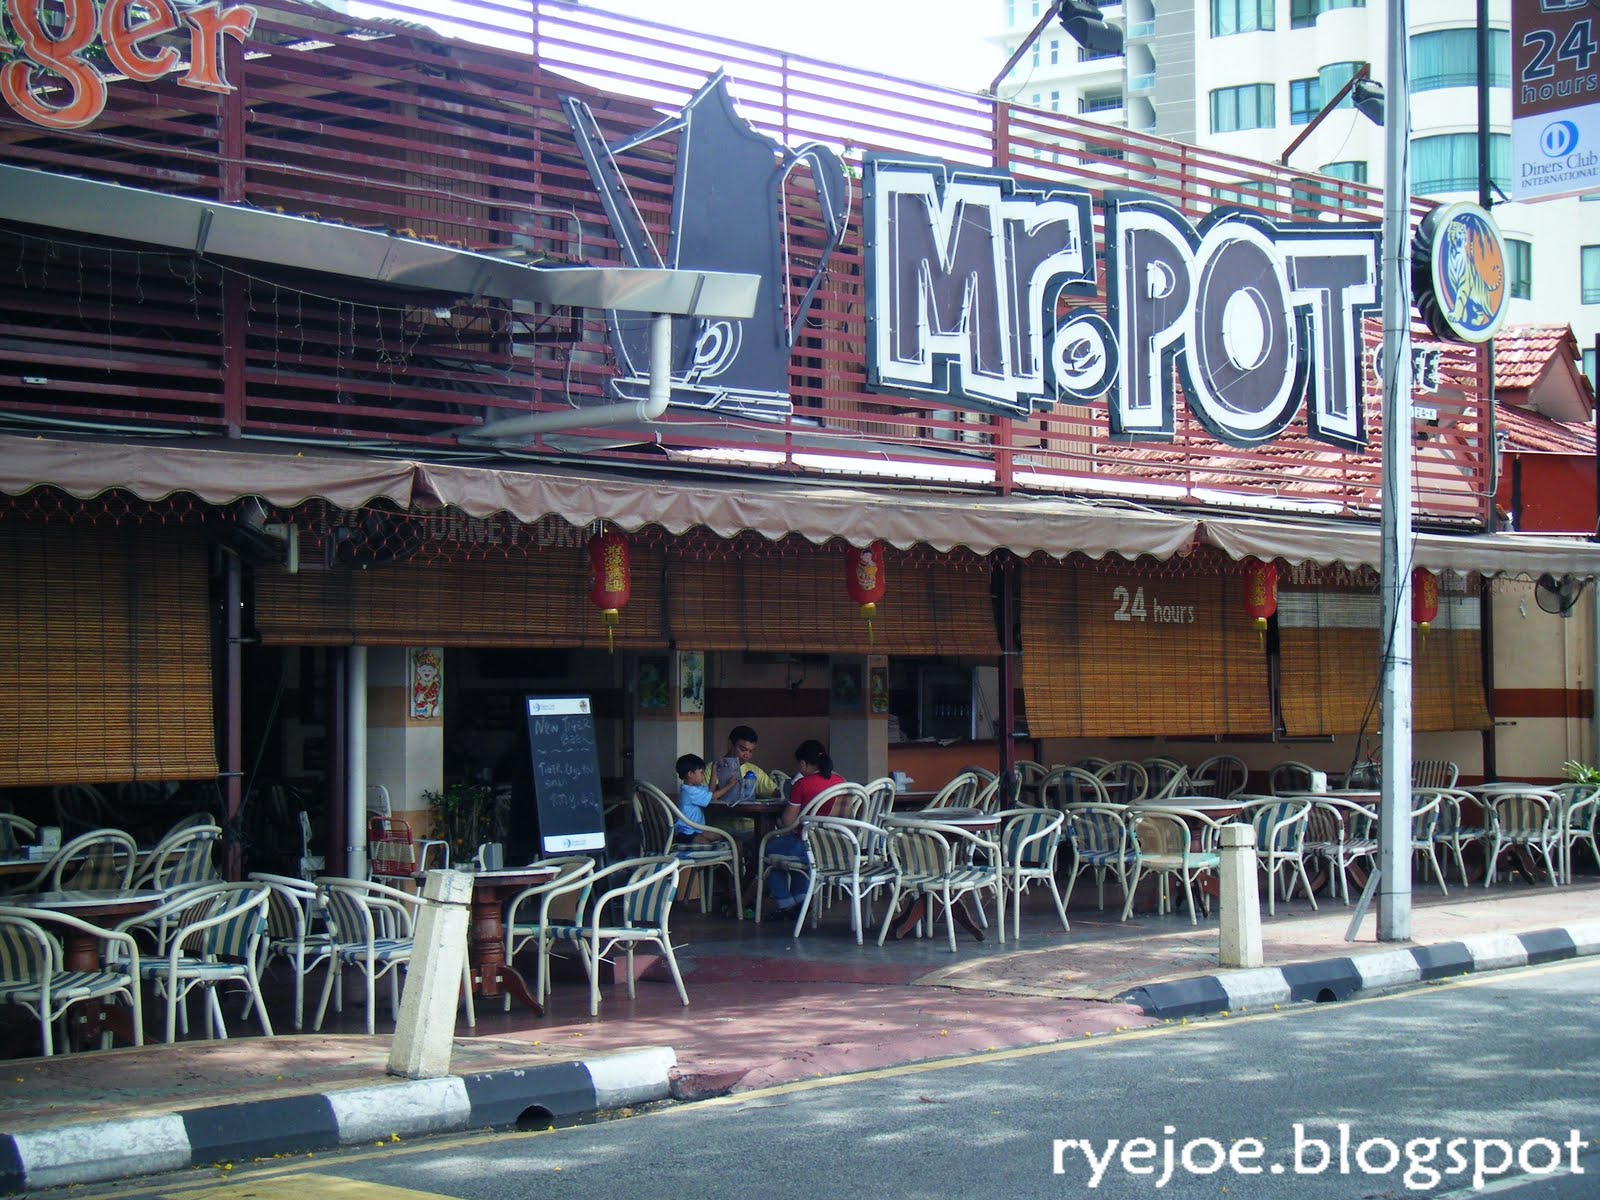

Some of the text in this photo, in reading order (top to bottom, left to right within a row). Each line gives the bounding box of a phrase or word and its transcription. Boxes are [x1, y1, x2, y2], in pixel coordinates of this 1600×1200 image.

[0, 0, 257, 129] ger
[1521, 19, 1598, 83] 24
[1521, 74, 1598, 105] hours
[1521, 150, 1599, 178] Diners Club
[1521, 167, 1598, 188] INTERNATIONAL
[1113, 585, 1195, 624] 24 hours
